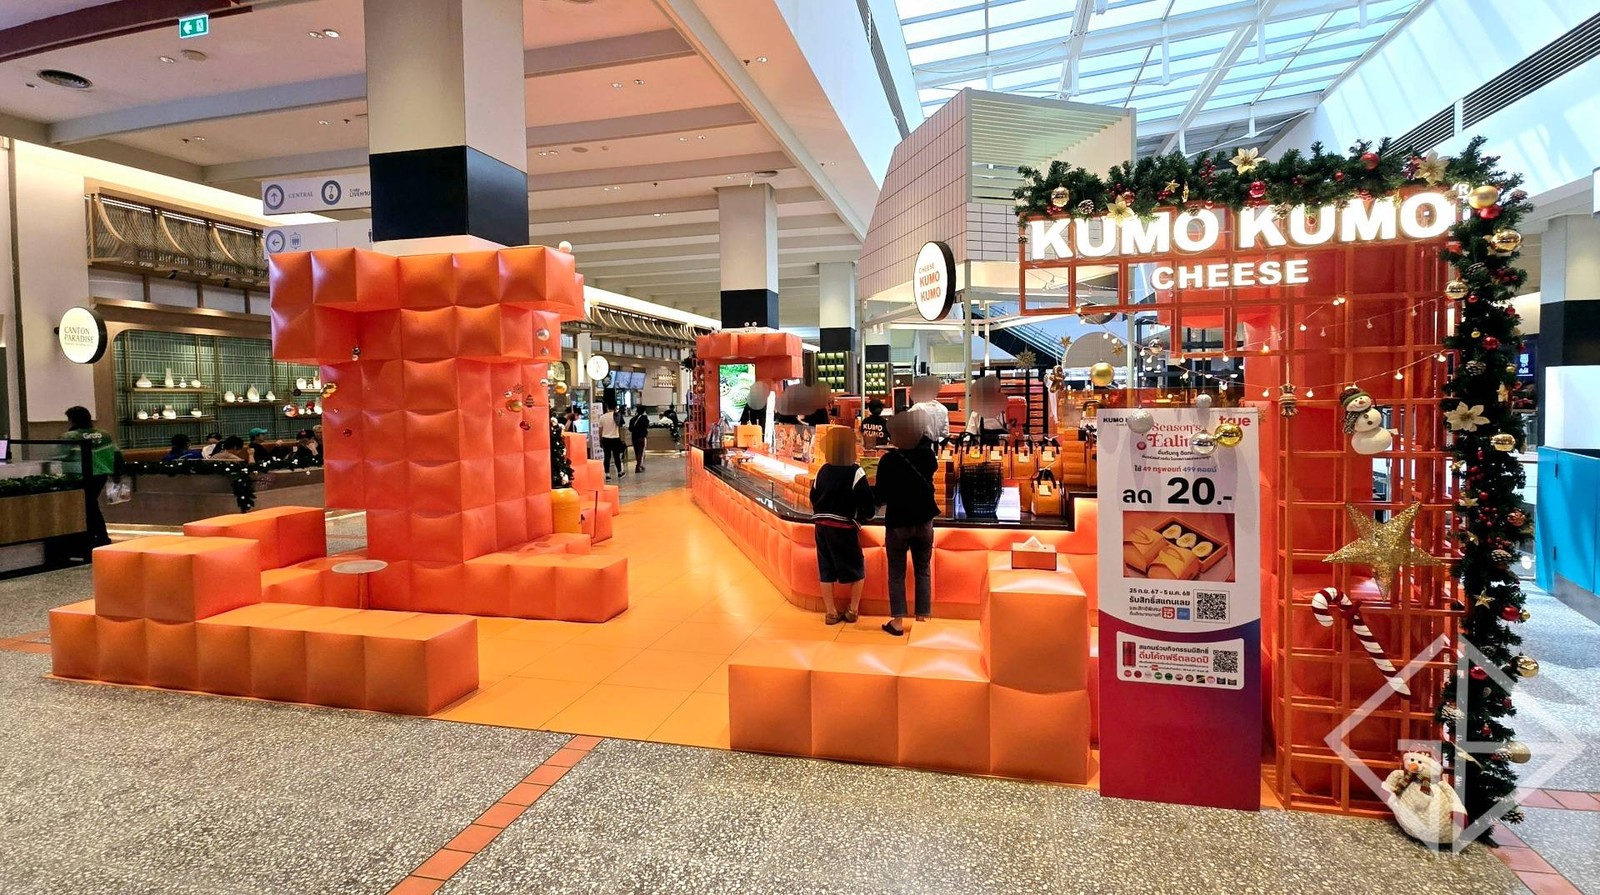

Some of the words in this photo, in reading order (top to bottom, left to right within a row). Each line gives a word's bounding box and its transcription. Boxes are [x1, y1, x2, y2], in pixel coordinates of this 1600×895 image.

[287, 191, 313, 199] CENTRAL
[1030, 209, 1219, 260] KUMO
[1238, 192, 1452, 249] KUMO
[918, 262, 935, 274] CHEESE
[919, 270, 941, 288] KUMO
[1150, 259, 1309, 290] CHEESE
[920, 286, 942, 303] KUMO
[64, 326, 90, 335] CANTON
[64, 335, 94, 344] PARADISE
[862, 423, 883, 431] KUMO
[1151, 422, 1202, 434] Season's
[82, 432, 102, 440] Grab
[863, 430, 884, 438] KUMO
[1122, 489, 1153, 504] ลด
[1167, 477, 1233, 505] 20.-
